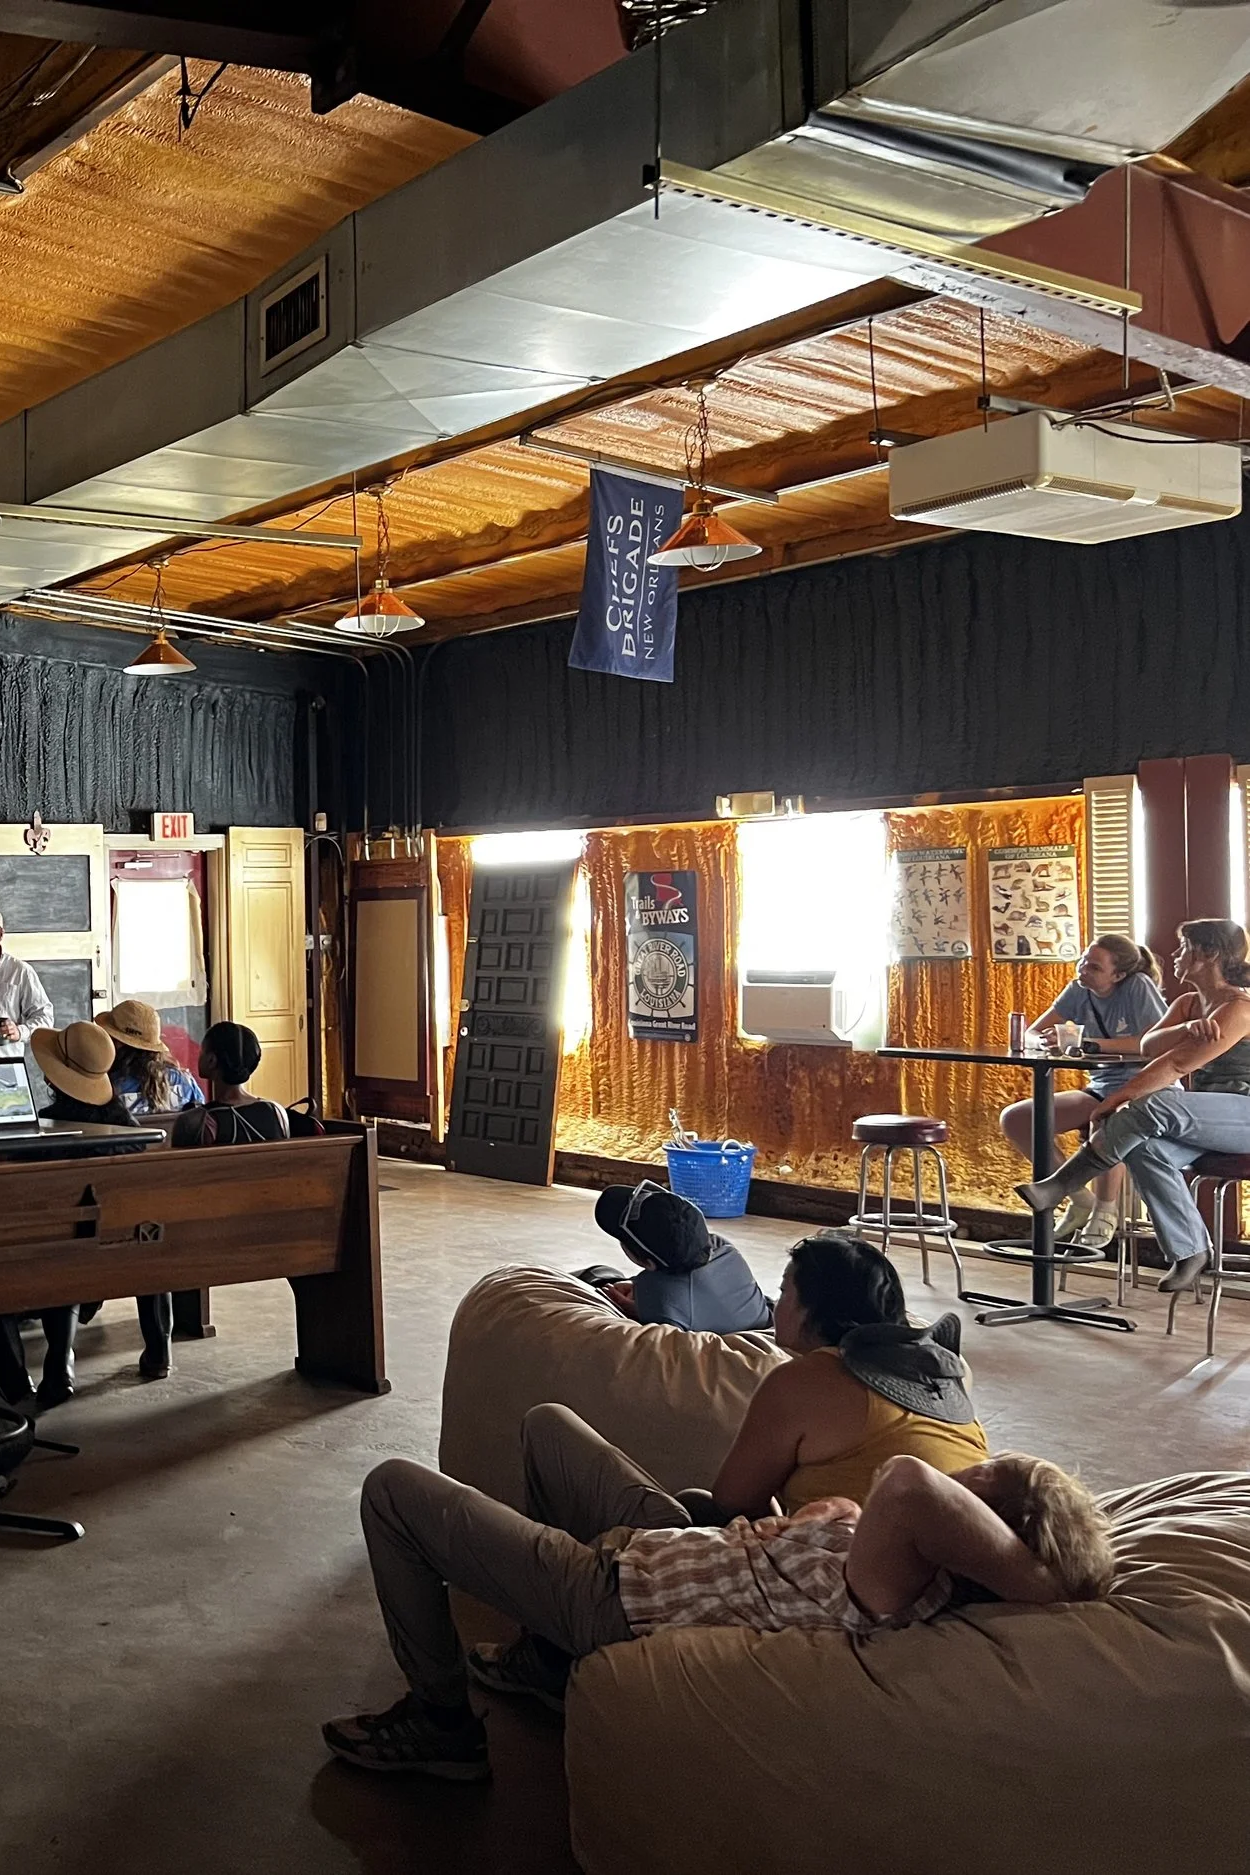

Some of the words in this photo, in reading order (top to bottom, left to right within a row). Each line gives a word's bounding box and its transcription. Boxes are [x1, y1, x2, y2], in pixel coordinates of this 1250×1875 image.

[647, 504, 665, 605] ORLANS
[605, 514, 624, 632] CHEFS
[621, 497, 645, 658] BRIGADE
[644, 613, 655, 660] NEW
[161, 814, 188, 839] EXIT
[631, 895, 655, 910] Trails
[641, 908, 689, 926] BYWAYS
[670, 950, 686, 978] ROAD
[640, 989, 682, 1008] LOUISIANA
